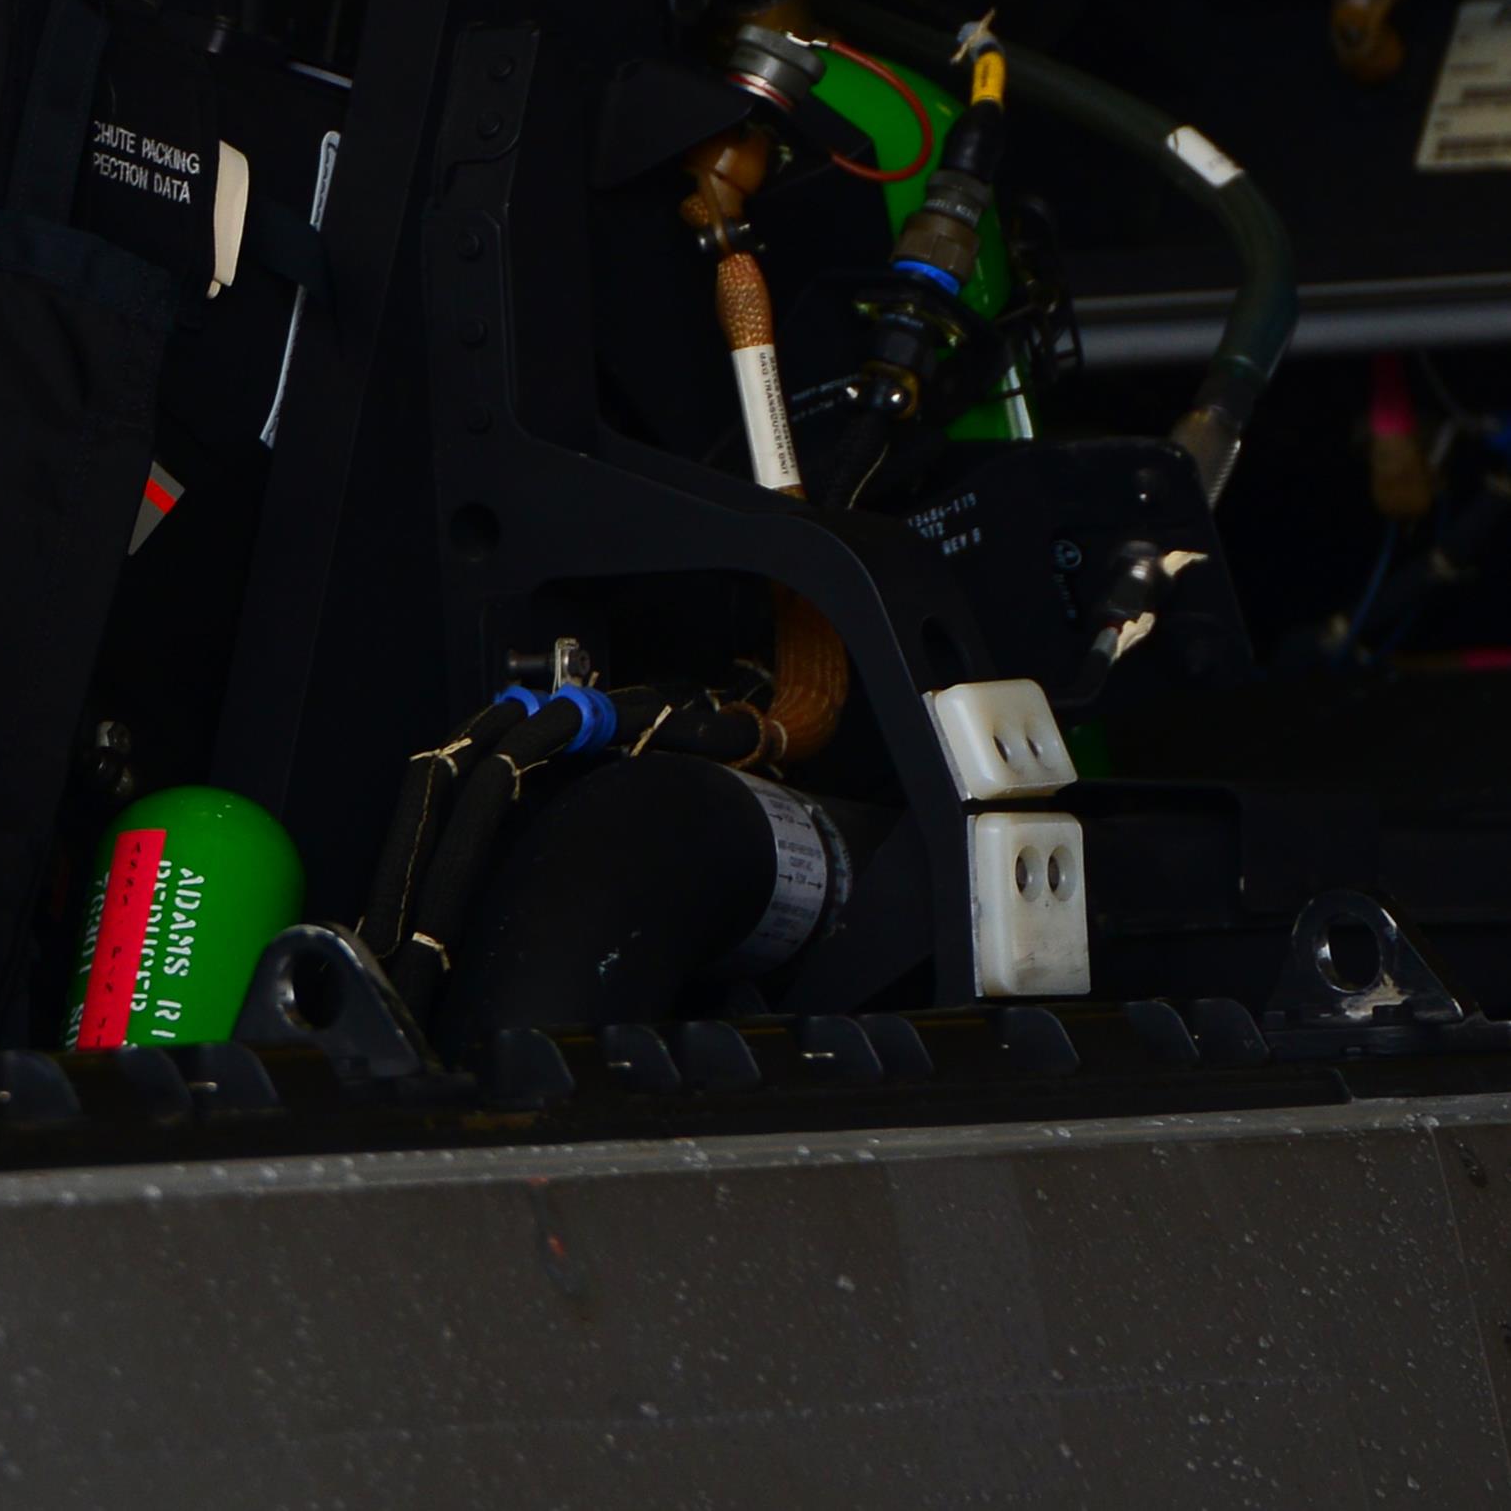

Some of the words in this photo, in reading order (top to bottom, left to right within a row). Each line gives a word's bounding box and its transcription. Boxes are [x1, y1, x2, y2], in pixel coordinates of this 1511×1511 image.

[141, 137, 201, 175] PACKING
[153, 171, 192, 205] DATA
[163, 867, 206, 978] ADAMS
